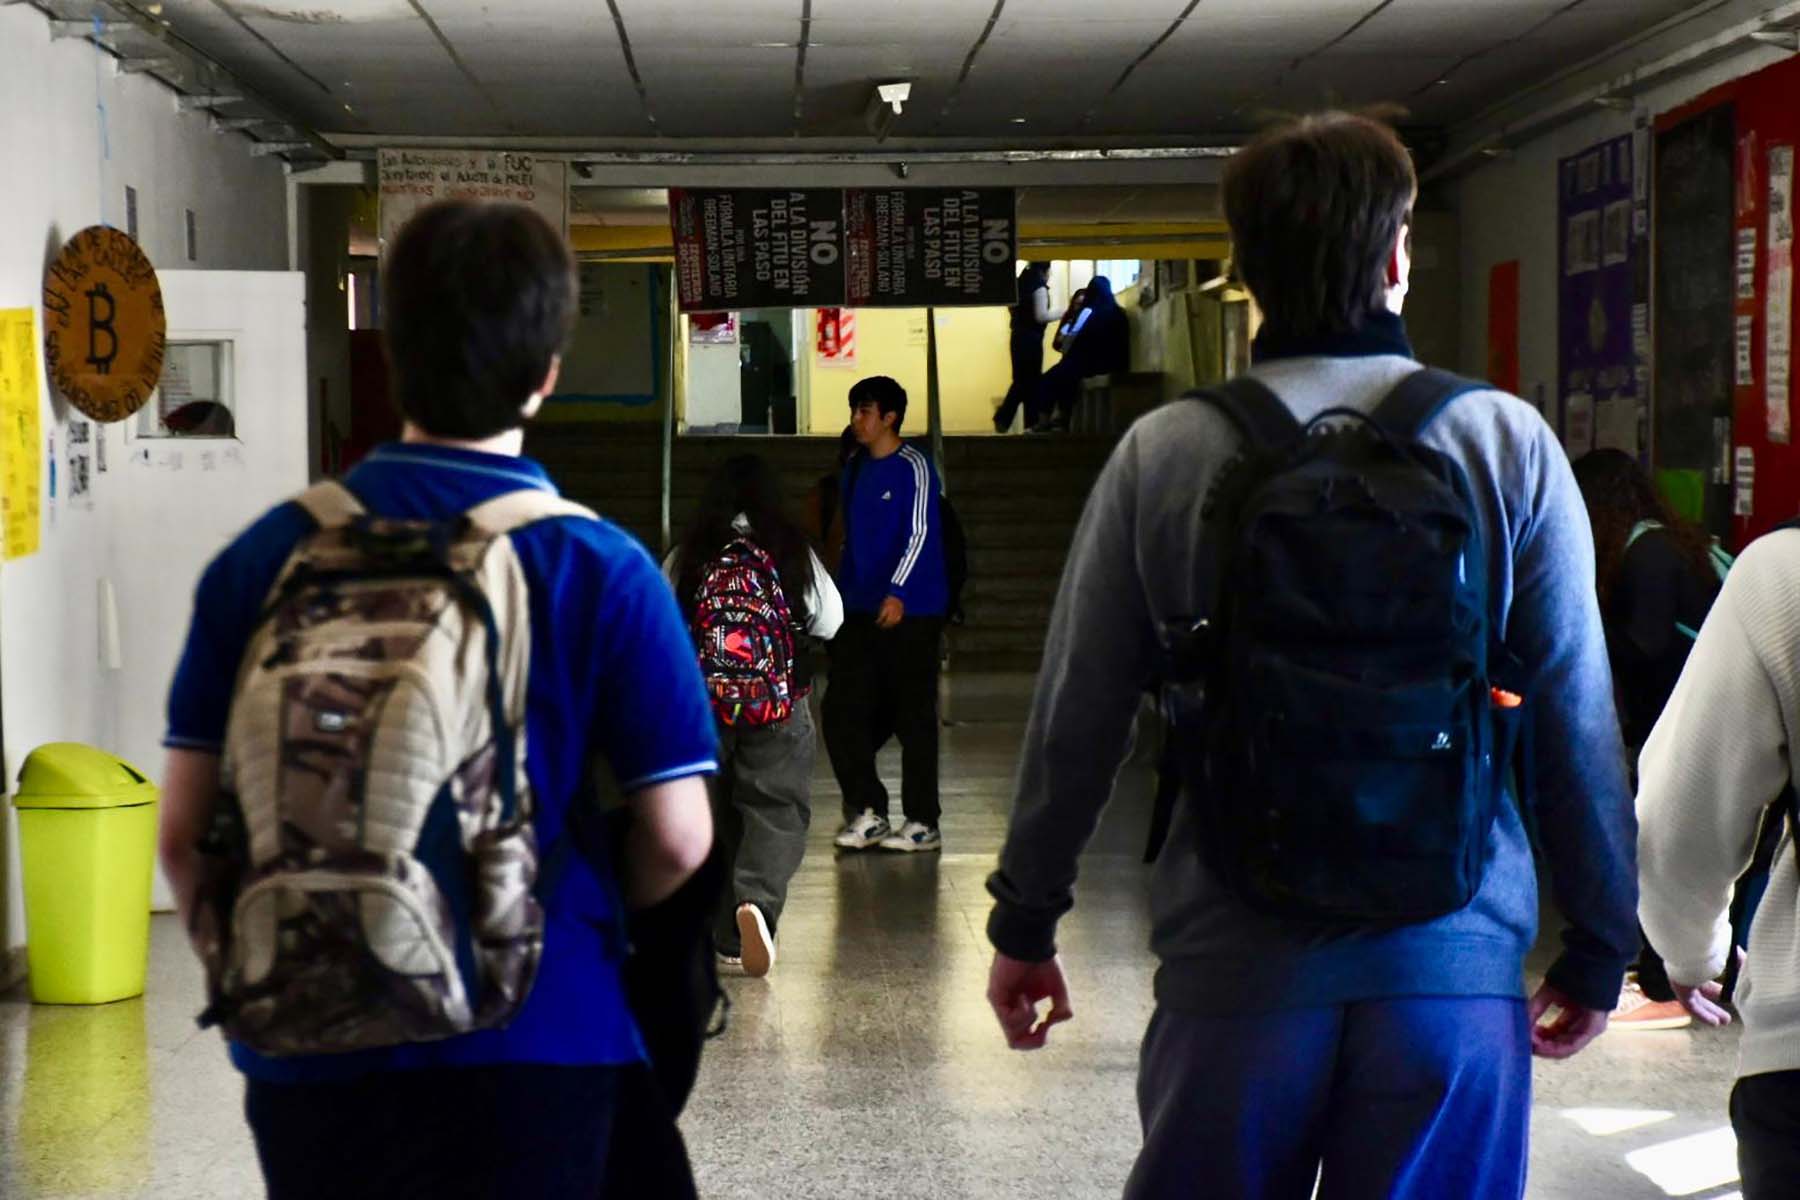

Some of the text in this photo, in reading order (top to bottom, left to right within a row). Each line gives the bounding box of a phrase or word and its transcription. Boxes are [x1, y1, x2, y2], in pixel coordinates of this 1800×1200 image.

[720, 194, 738, 298] FÓRMULA UNITARIA
[752, 209, 770, 280] LAS PASO
[770, 200, 789, 289] DEL FITU EN
[790, 192, 809, 295] A LA DIVISIÓN
[809, 220, 838, 265] NO
[890, 191, 905, 295] FÓRMULA UNITARIA
[924, 207, 940, 278] LAS PASO
[943, 198, 960, 287] DEL FITU EN
[962, 191, 982, 293] A LA DIVISIÓN
[982, 219, 1010, 263] NO
